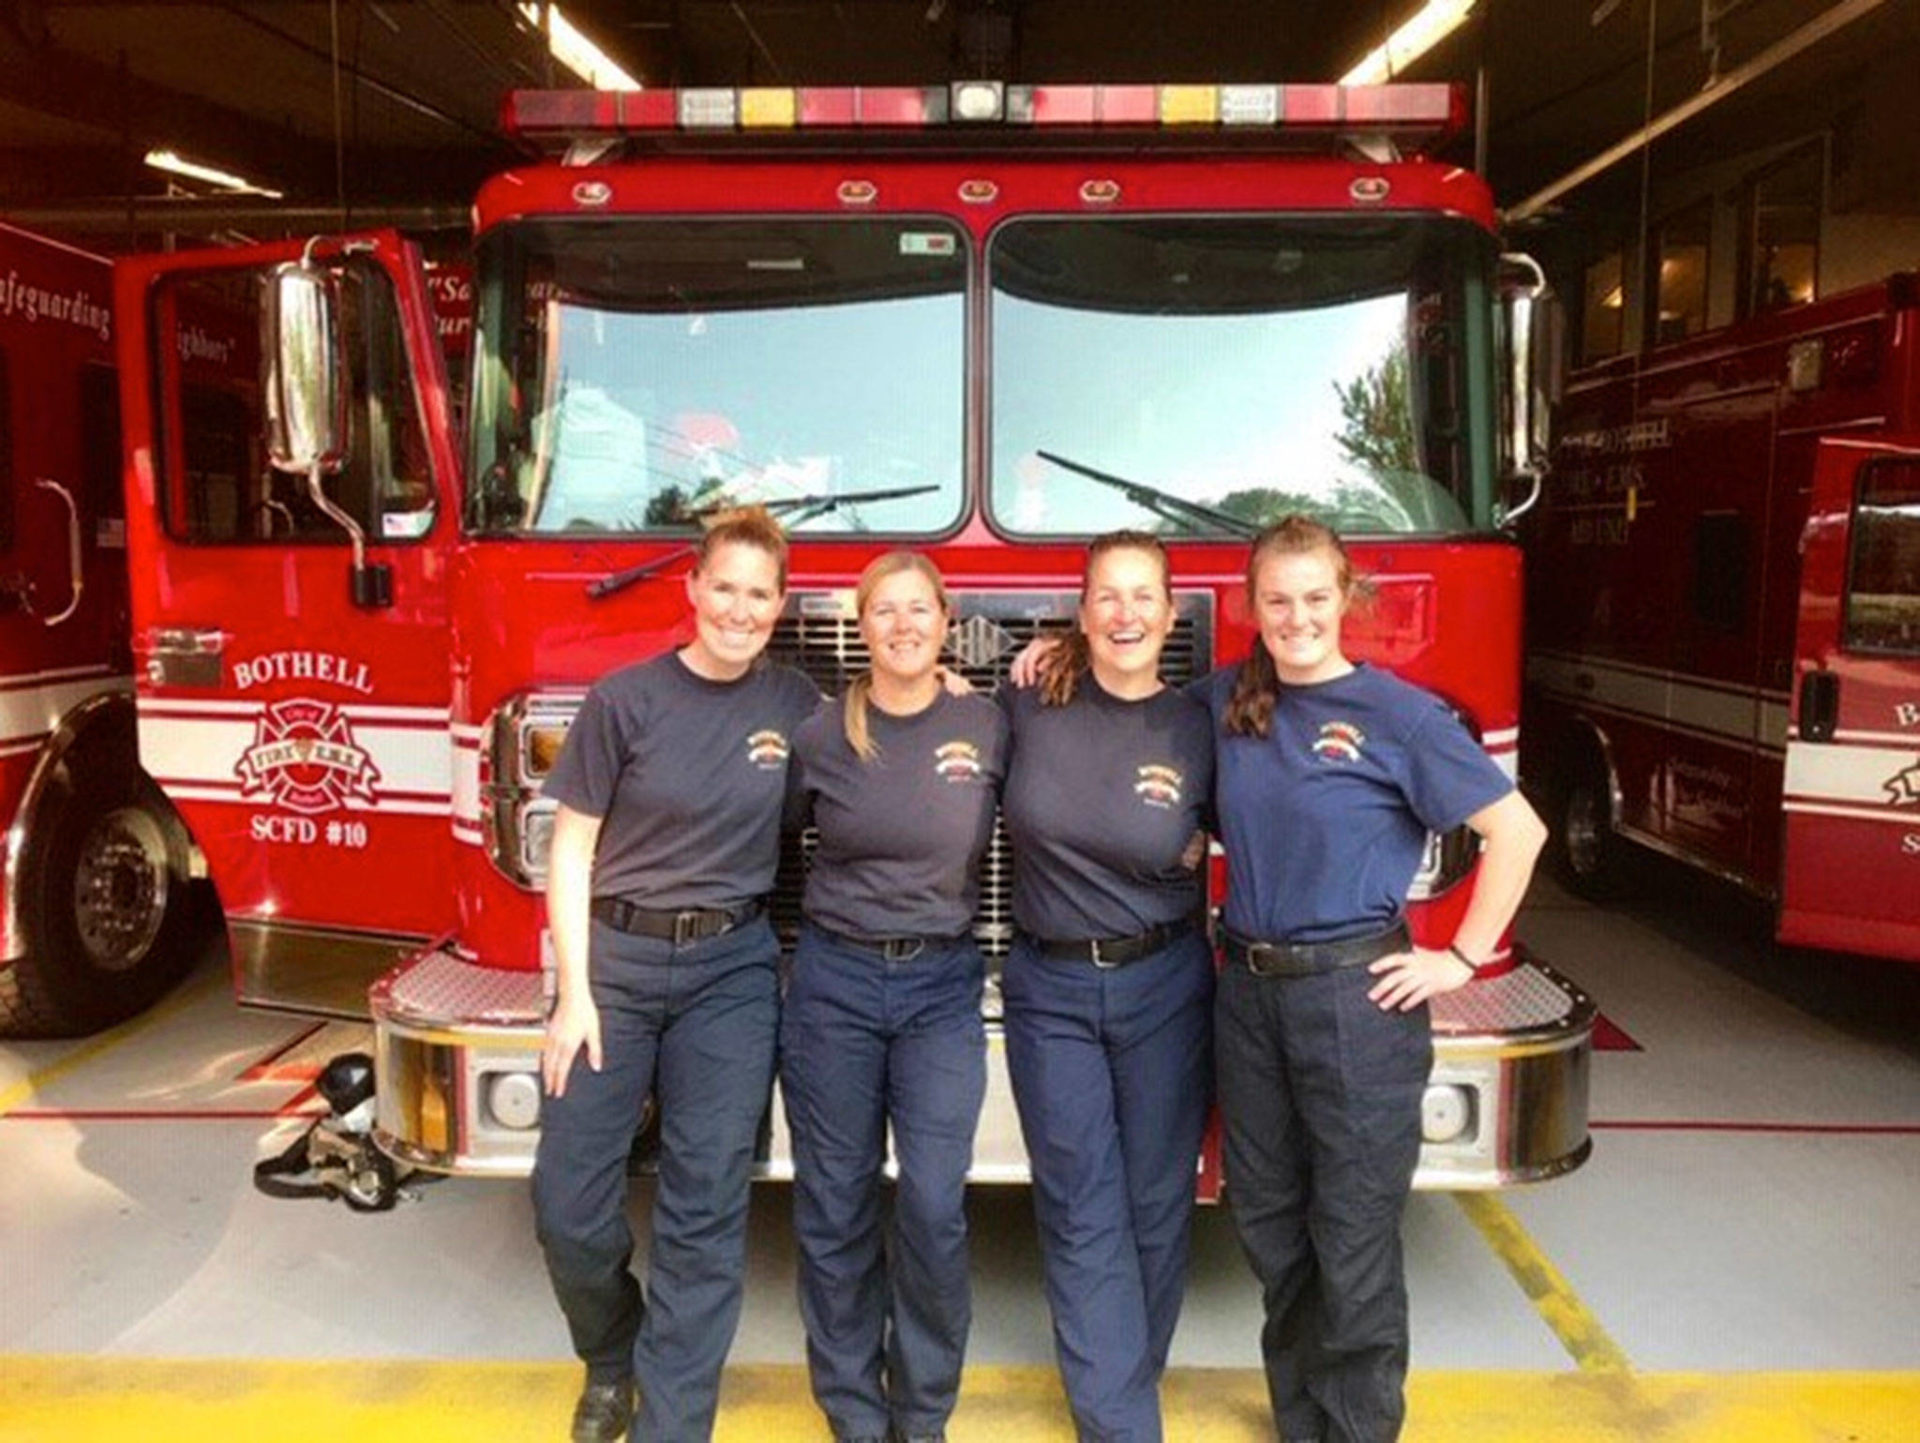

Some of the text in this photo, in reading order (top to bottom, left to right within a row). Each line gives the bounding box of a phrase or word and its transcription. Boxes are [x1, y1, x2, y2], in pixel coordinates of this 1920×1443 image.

[233, 652, 373, 693] BOTHELL
[251, 815, 367, 847] SCFD #10
